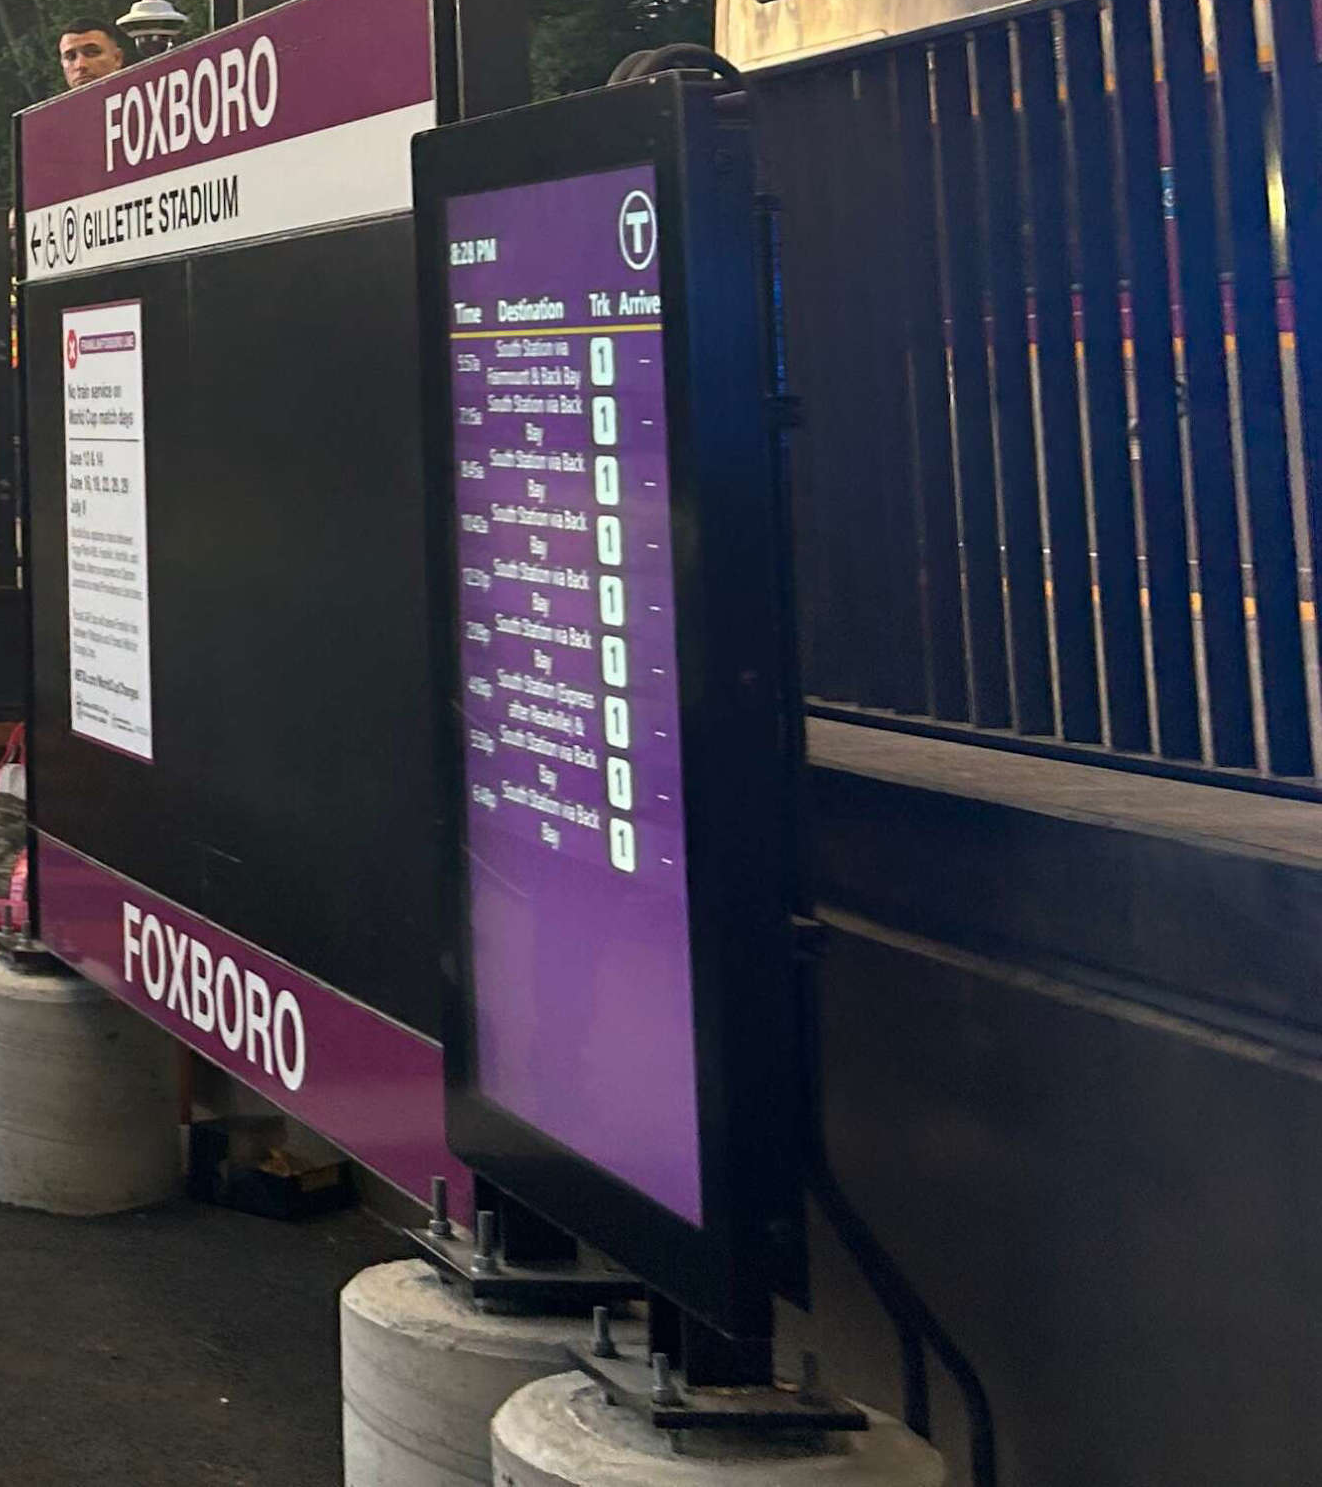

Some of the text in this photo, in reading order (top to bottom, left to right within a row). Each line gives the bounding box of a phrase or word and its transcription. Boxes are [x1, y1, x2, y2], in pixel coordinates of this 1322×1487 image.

[105, 35, 278, 172] FOXBORO
[84, 197, 153, 250] GILLETTE
[159, 175, 239, 234] STADIUM
[476, 238, 496, 263] PM
[454, 303, 482, 324] Time
[498, 297, 564, 322] Destination
[589, 293, 612, 317] Trk
[563, 367, 581, 389] Bay
[123, 901, 306, 1091] FOXBORO
